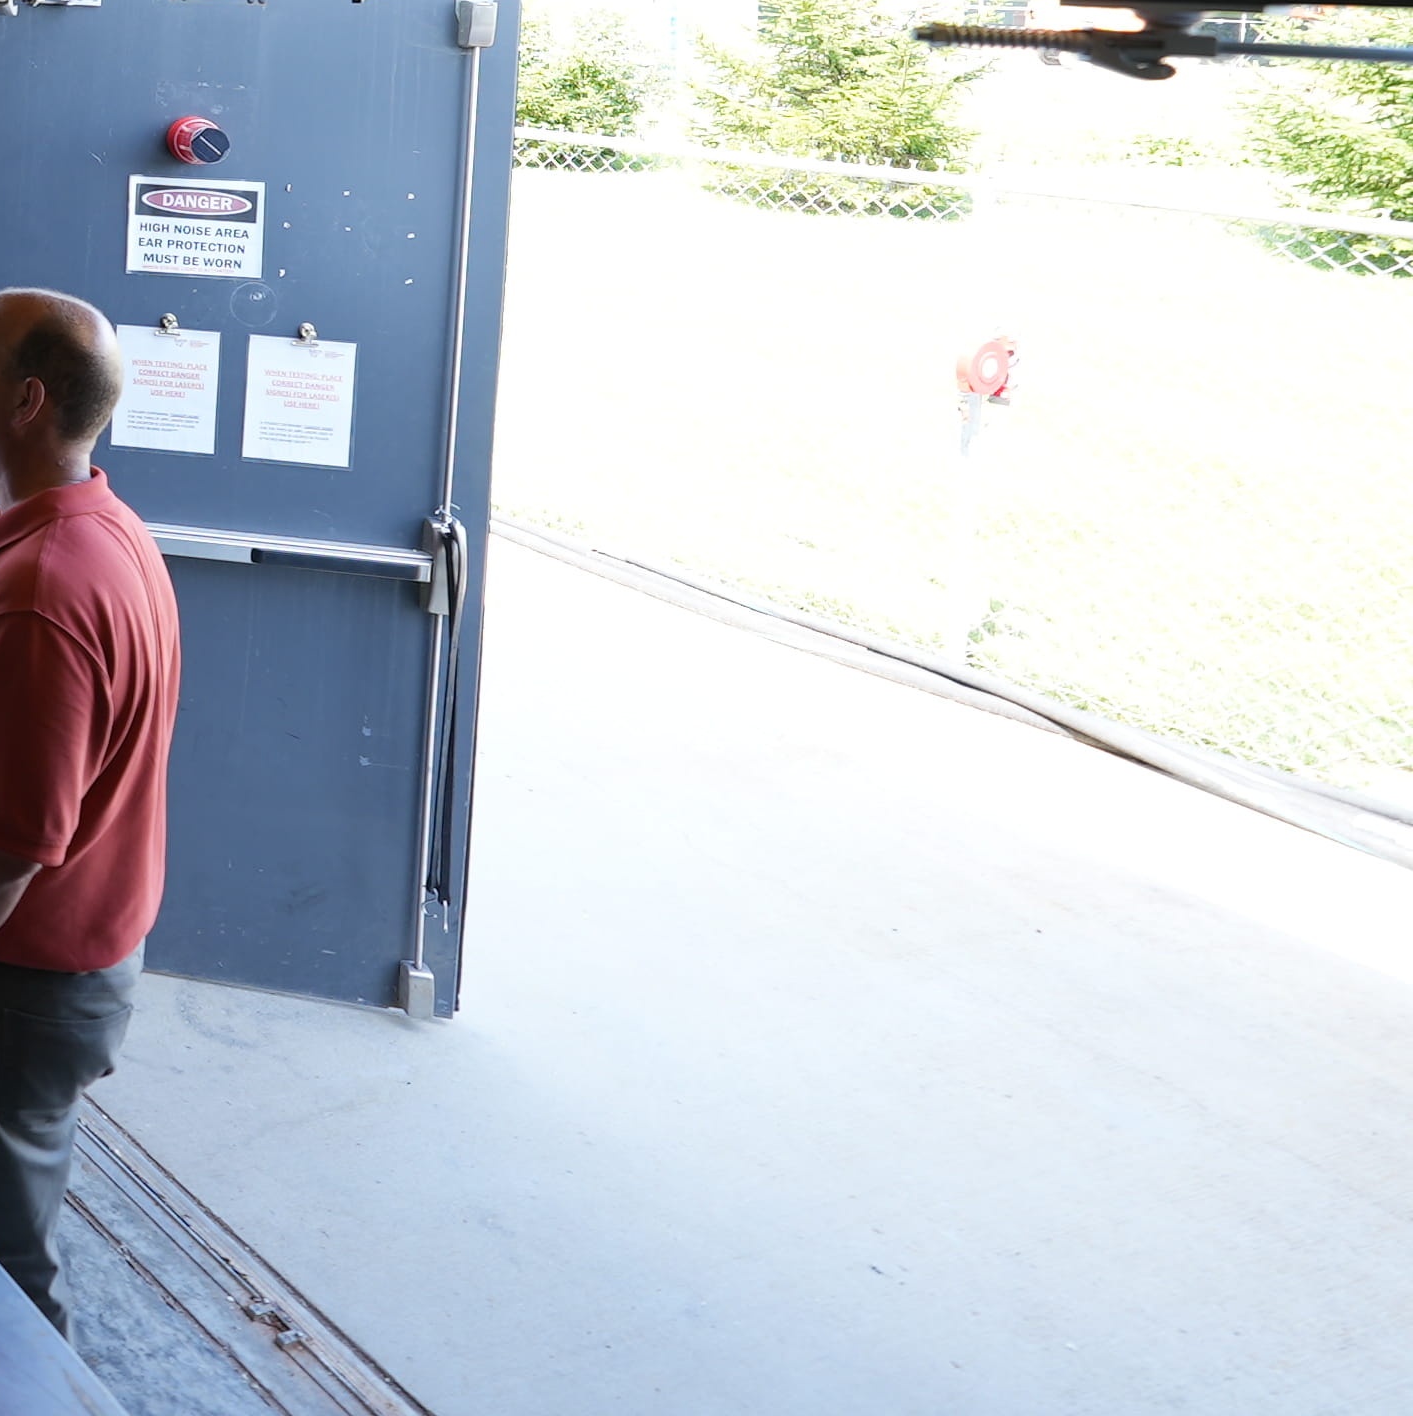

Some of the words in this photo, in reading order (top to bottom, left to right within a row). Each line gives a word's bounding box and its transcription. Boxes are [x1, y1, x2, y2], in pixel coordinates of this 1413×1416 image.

[162, 193, 233, 211] DANGER
[139, 222, 170, 233] HIGH
[173, 225, 212, 236] NOISE
[214, 228, 249, 239] AREA
[138, 237, 163, 248] EAR
[167, 239, 245, 254] PROTECTION
[143, 253, 179, 264] MUST
[182, 256, 200, 266] BE
[203, 257, 242, 269] WORN
[131, 359, 154, 367] WHEN
[186, 363, 208, 371] PLACE
[138, 368, 170, 377] CORRECT
[171, 371, 200, 380] DANGER
[264, 369, 287, 377] WHEN
[271, 379, 303, 388] CORRECT
[305, 382, 335, 391] DANGER
